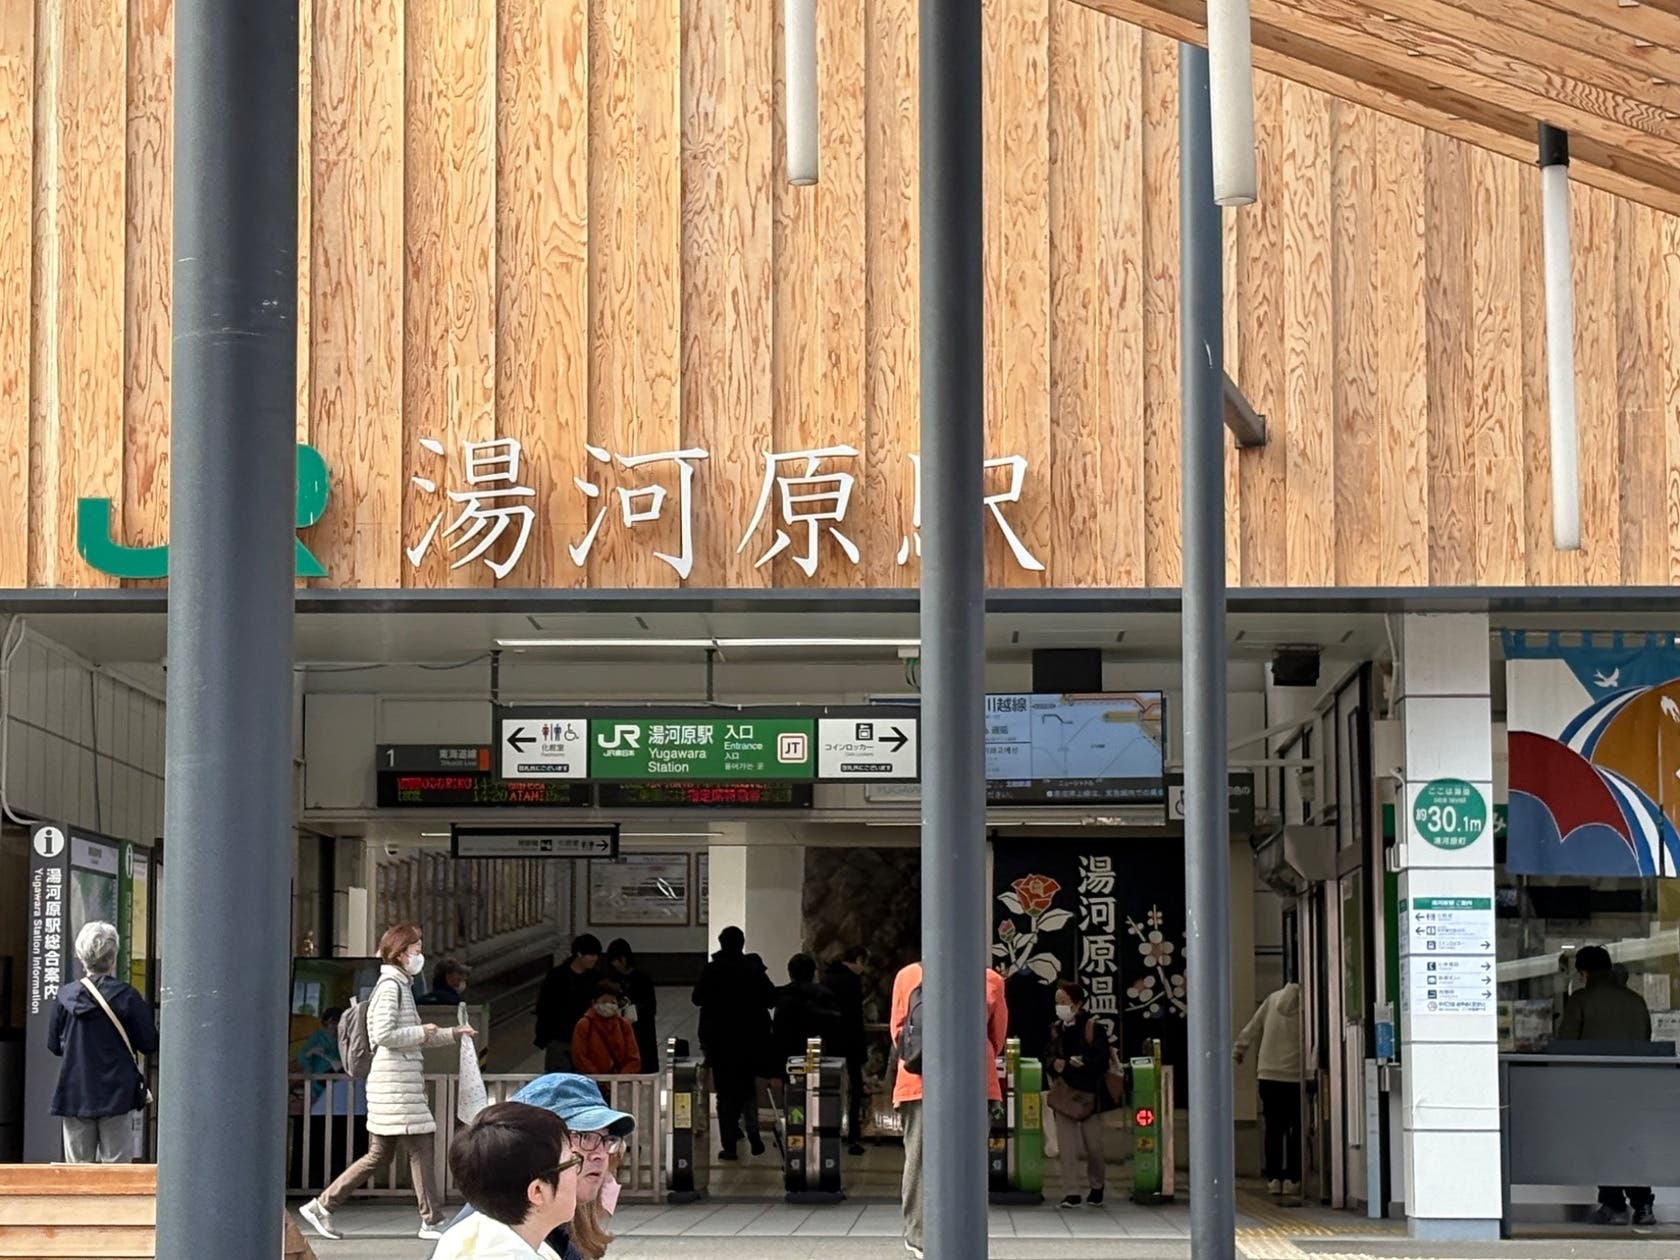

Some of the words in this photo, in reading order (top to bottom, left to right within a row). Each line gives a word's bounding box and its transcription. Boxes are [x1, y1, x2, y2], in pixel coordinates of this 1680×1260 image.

[77, 443, 328, 578] J
[598, 725, 640, 749] JR
[648, 725, 713, 745] 湯河原駅
[724, 725, 753, 739] 入口
[648, 747, 707, 762] Yugawara
[724, 742, 763, 750] Entrance
[785, 742, 800, 754] JT
[386, 749, 394, 767] 1
[724, 752, 740, 760] 入口
[648, 761, 689, 773] Station
[32, 868, 44, 917] Yugawara
[32, 920, 43, 954] Station
[44, 868, 62, 1000] 湯河原駅総合案内
[31, 957, 42, 1014] Information
